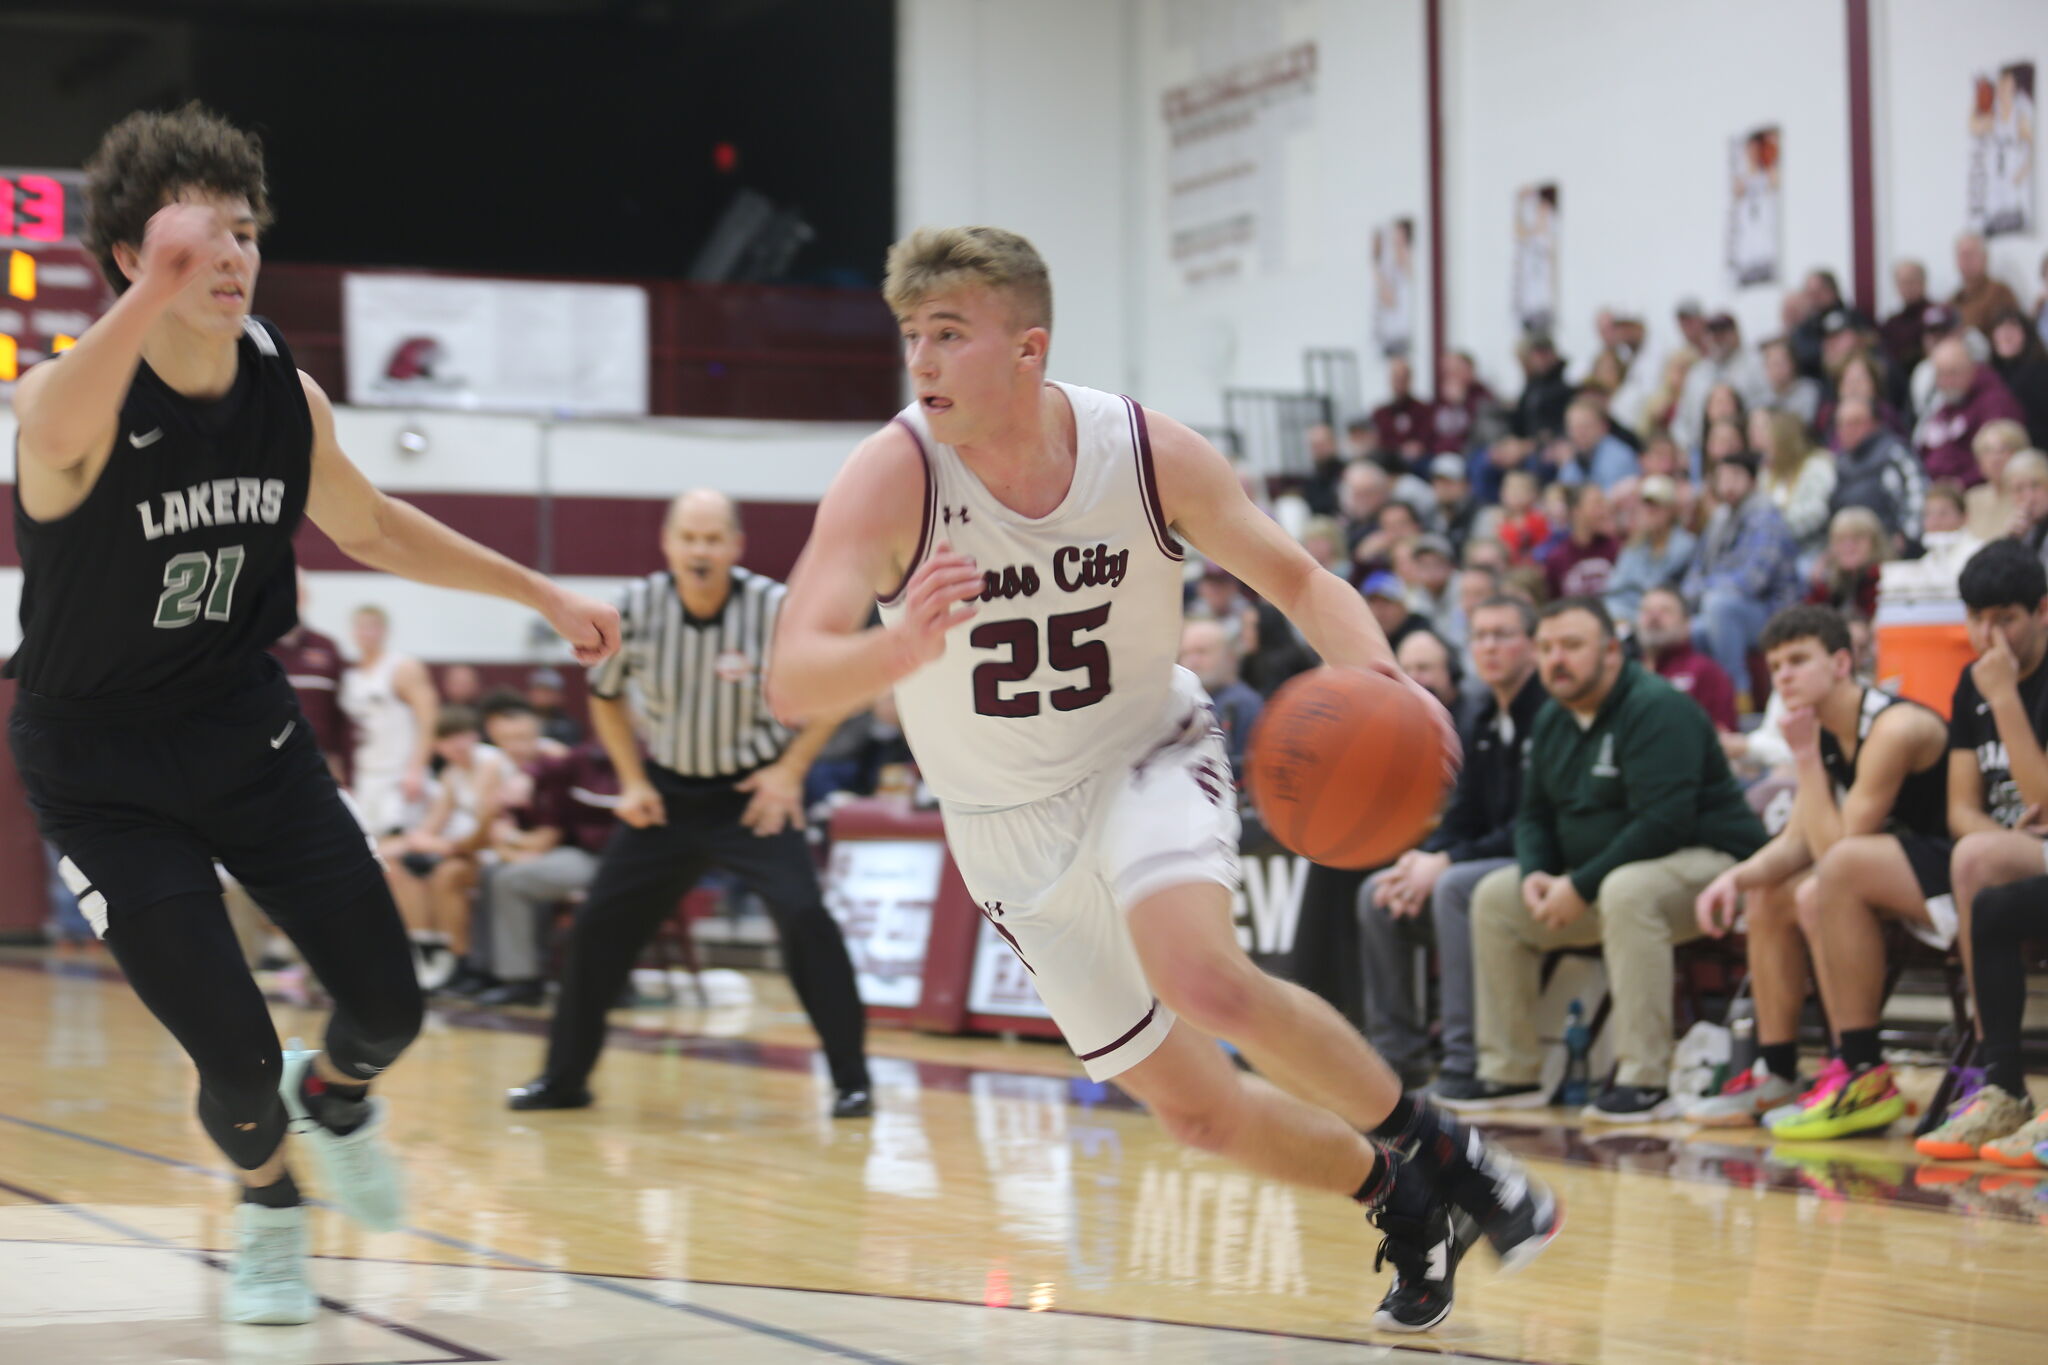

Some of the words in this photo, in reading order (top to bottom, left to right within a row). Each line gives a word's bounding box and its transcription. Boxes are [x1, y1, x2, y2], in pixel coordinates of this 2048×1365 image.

[135, 477, 286, 541] LAKERS
[153, 544, 245, 629] 21
[962, 563, 1041, 603] ass
[1053, 543, 1129, 592] City
[970, 601, 1113, 718] 25
